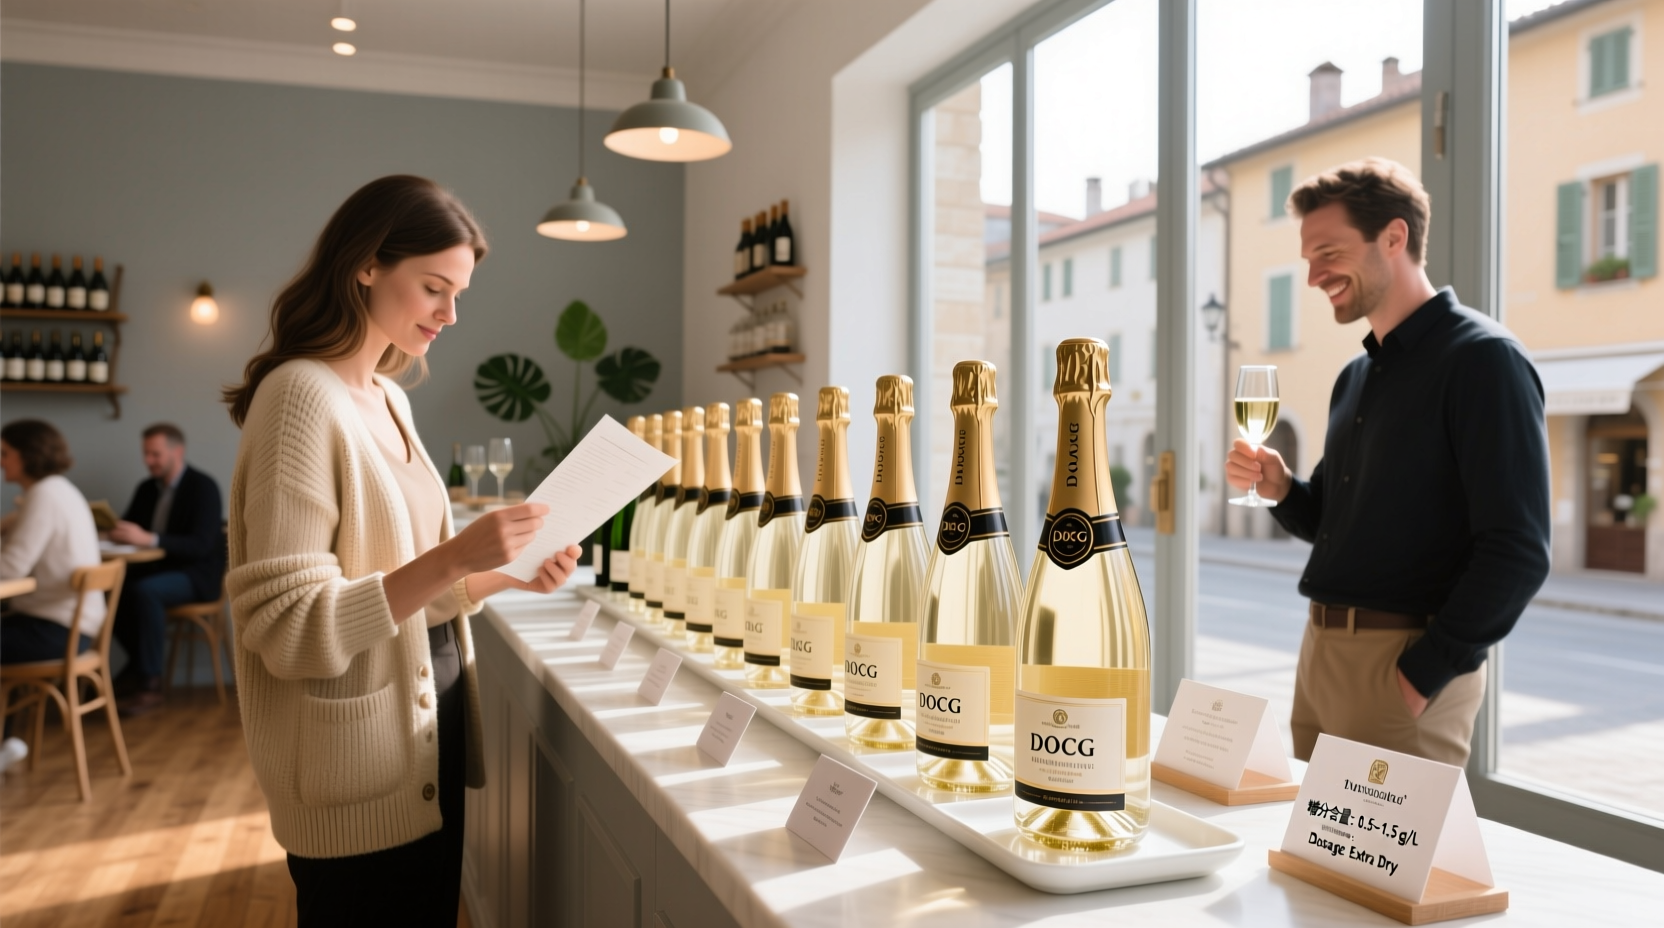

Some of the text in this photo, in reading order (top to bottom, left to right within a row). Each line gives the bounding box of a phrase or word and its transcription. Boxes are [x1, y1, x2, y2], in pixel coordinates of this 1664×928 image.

[919, 692, 961, 714] DOCG
[1030, 732, 1095, 757] DOCG
[1377, 854, 1399, 877] Dry
